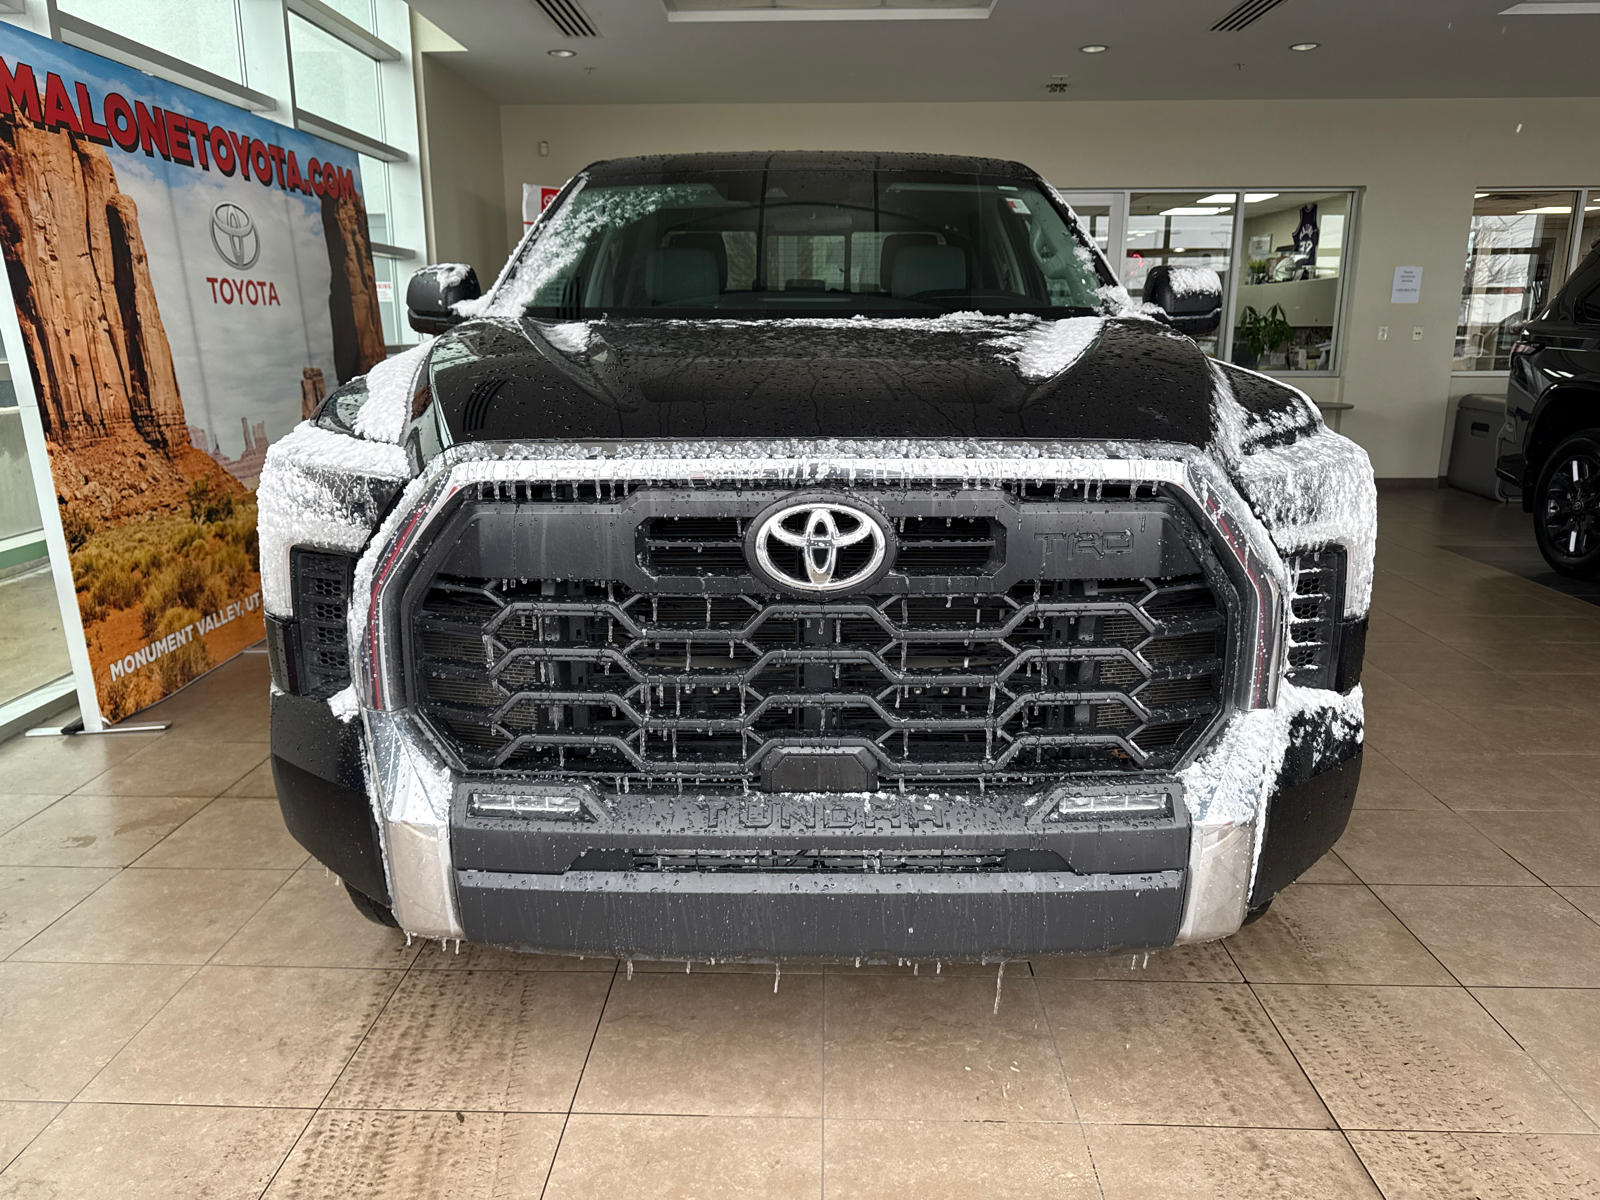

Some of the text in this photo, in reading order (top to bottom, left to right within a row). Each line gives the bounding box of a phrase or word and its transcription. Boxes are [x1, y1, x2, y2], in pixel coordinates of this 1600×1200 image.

[0, 56, 357, 201] MALONETOYOTA.COM
[206, 276, 281, 307] TOYOTA
[1034, 532, 1134, 561] TRD
[109, 591, 260, 682] MONUMENT VALLEY, UT
[697, 801, 944, 829] TUNDRA
